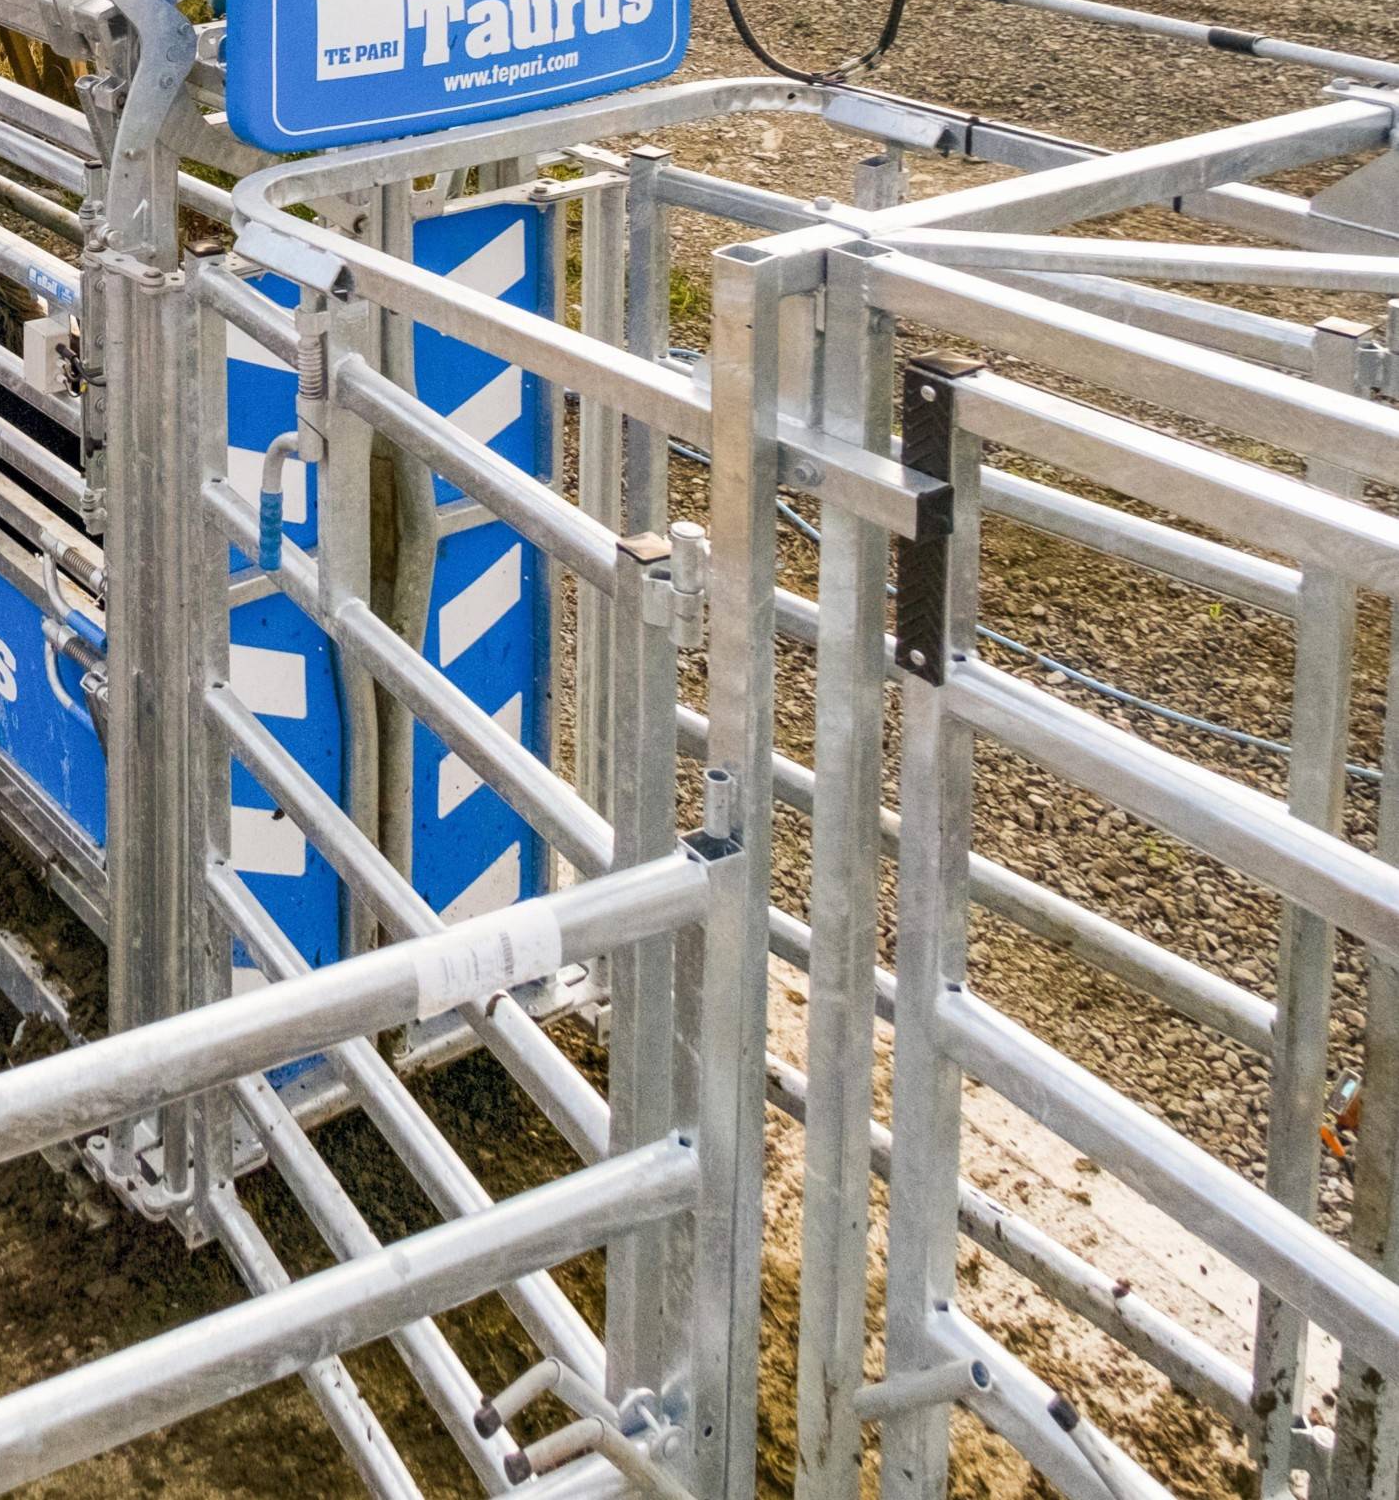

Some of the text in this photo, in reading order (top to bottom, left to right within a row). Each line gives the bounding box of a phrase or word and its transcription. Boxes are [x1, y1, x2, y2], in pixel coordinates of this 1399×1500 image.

[324, 40, 399, 66] TE PARI
[443, 50, 579, 93] www.tepari.com
